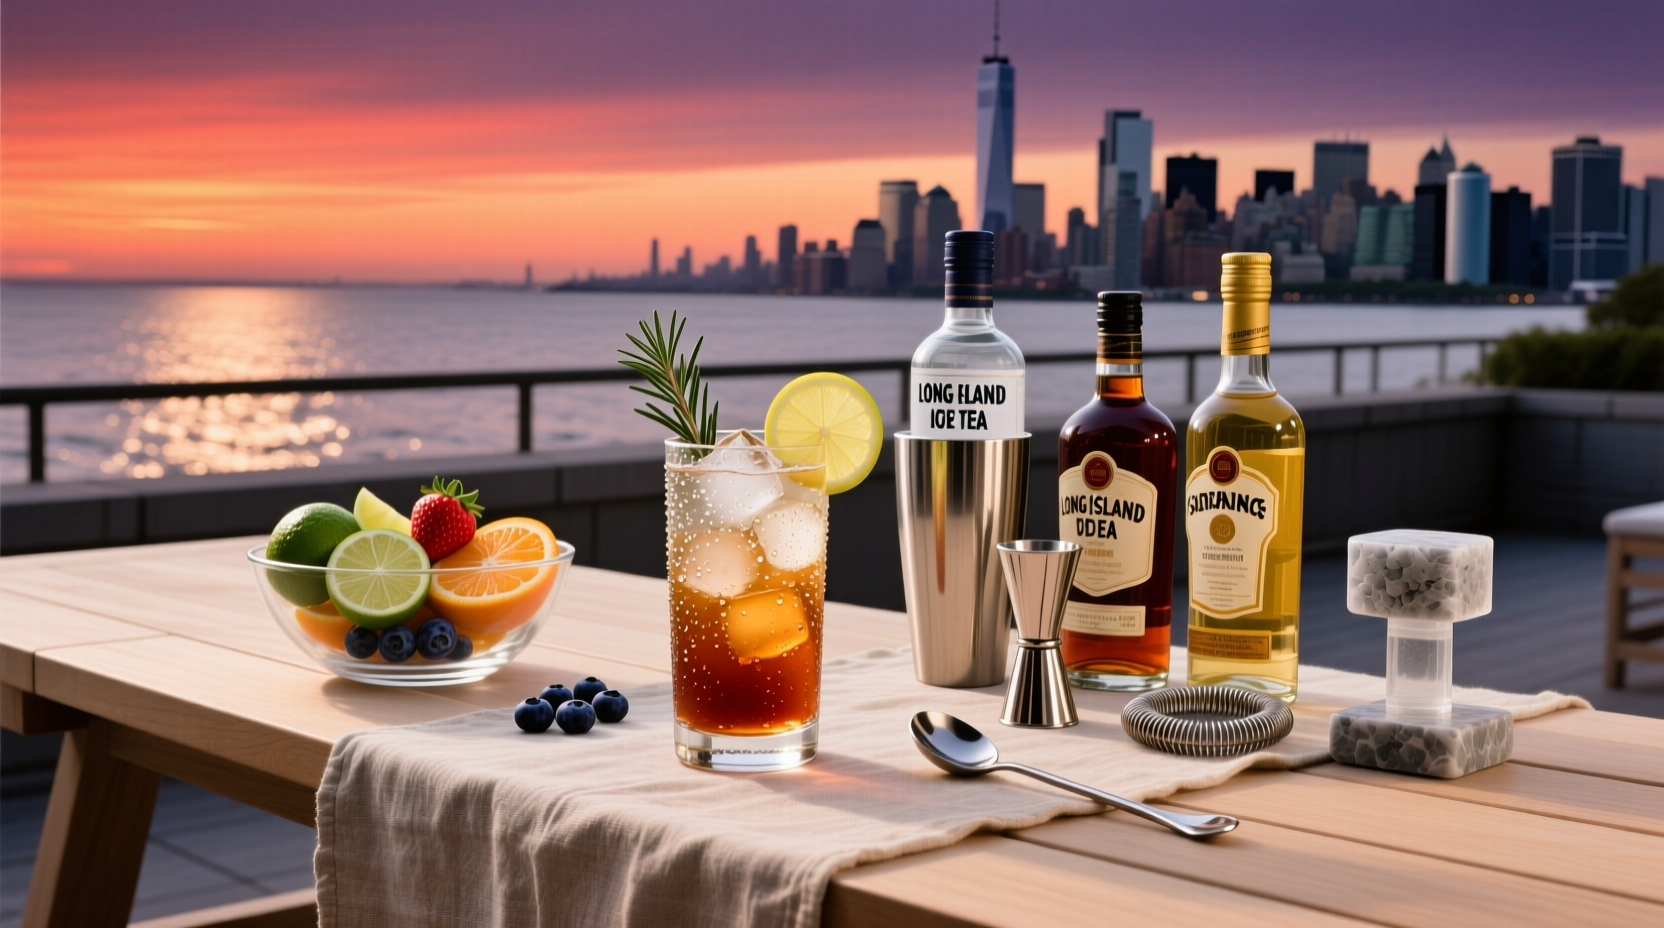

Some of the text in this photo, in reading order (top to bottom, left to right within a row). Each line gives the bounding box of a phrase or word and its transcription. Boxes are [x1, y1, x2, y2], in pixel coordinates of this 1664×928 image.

[918, 382, 954, 404] LONG
[958, 409, 988, 431] TEA
[1061, 494, 1146, 524] LONG ISLAND
